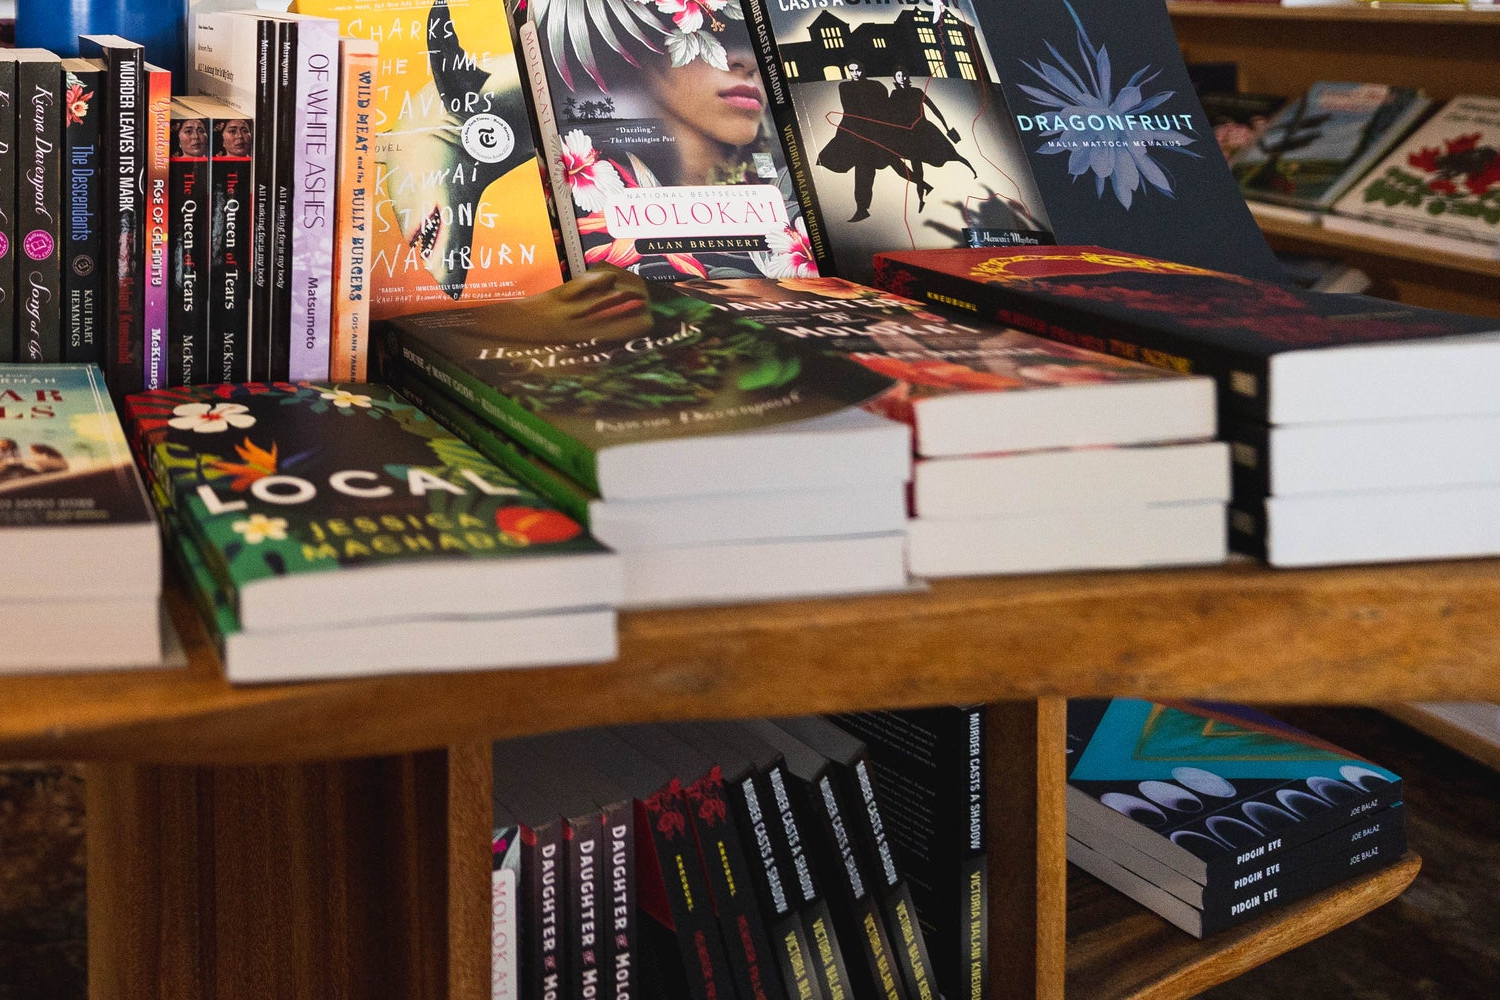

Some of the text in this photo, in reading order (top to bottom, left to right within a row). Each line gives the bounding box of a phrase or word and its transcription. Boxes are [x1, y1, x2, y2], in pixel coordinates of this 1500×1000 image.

[347, 18, 455, 42] SHARKS
[757, 24, 771, 54] CASTS
[764, 55, 773, 64] A
[767, 63, 785, 105] SHADOW
[118, 59, 135, 213] MURDER LEAVES ITS MARK
[622, 135, 676, 144] Washington Post
[1016, 114, 1195, 133] DRAGONFRUIT
[71, 144, 94, 165] The
[1047, 140, 1078, 148] MALIA
[1082, 140, 1129, 149] MATTOCH
[783, 124, 801, 169] VICTORIA
[796, 170, 812, 208] NALANI
[259, 184, 267, 197] All
[303, 53, 330, 350] OF WHITE ASHES Matsumoto
[350, 70, 372, 303] WILD MEAT and the BULLY BURGERS
[626, 190, 758, 199] NATIONAL BESTSELLER
[71, 168, 94, 241] Descendants
[257, 202, 266, 231] asking
[378, 200, 500, 233] STRONG
[180, 172, 197, 313] The Queen of Tears
[223, 171, 240, 311] The Queen of Tears
[258, 232, 266, 245] for
[648, 238, 760, 250] ALAN BRENNERT
[256, 268, 265, 287] body
[257, 253, 265, 267] my
[370, 243, 536, 278] WASHBURN
[149, 179, 165, 391] AGE OF CALAMITY McKinney
[415, 284, 451, 292] IMMEDIATELY
[71, 289, 80, 348] HEMMINGS
[84, 289, 93, 345] KAUI HART
[624, 321, 702, 354] Gods
[196, 468, 522, 515] LOCAL
[309, 512, 486, 541] JESSICA
[301, 531, 531, 562] MACHADO
[969, 712, 981, 850] MURDER CASTS SHADOW
[1236, 799, 1378, 865] PIDGIN EYE JOE BALAZ
[579, 838, 595, 947] DAUGHTER
[612, 824, 628, 931] DAUGHTER
[1231, 846, 1380, 916] PIDGIN EYE JOE BALAZ
[541, 843, 556, 953] DAUGHTER
[970, 871, 981, 920] VICTORIA
